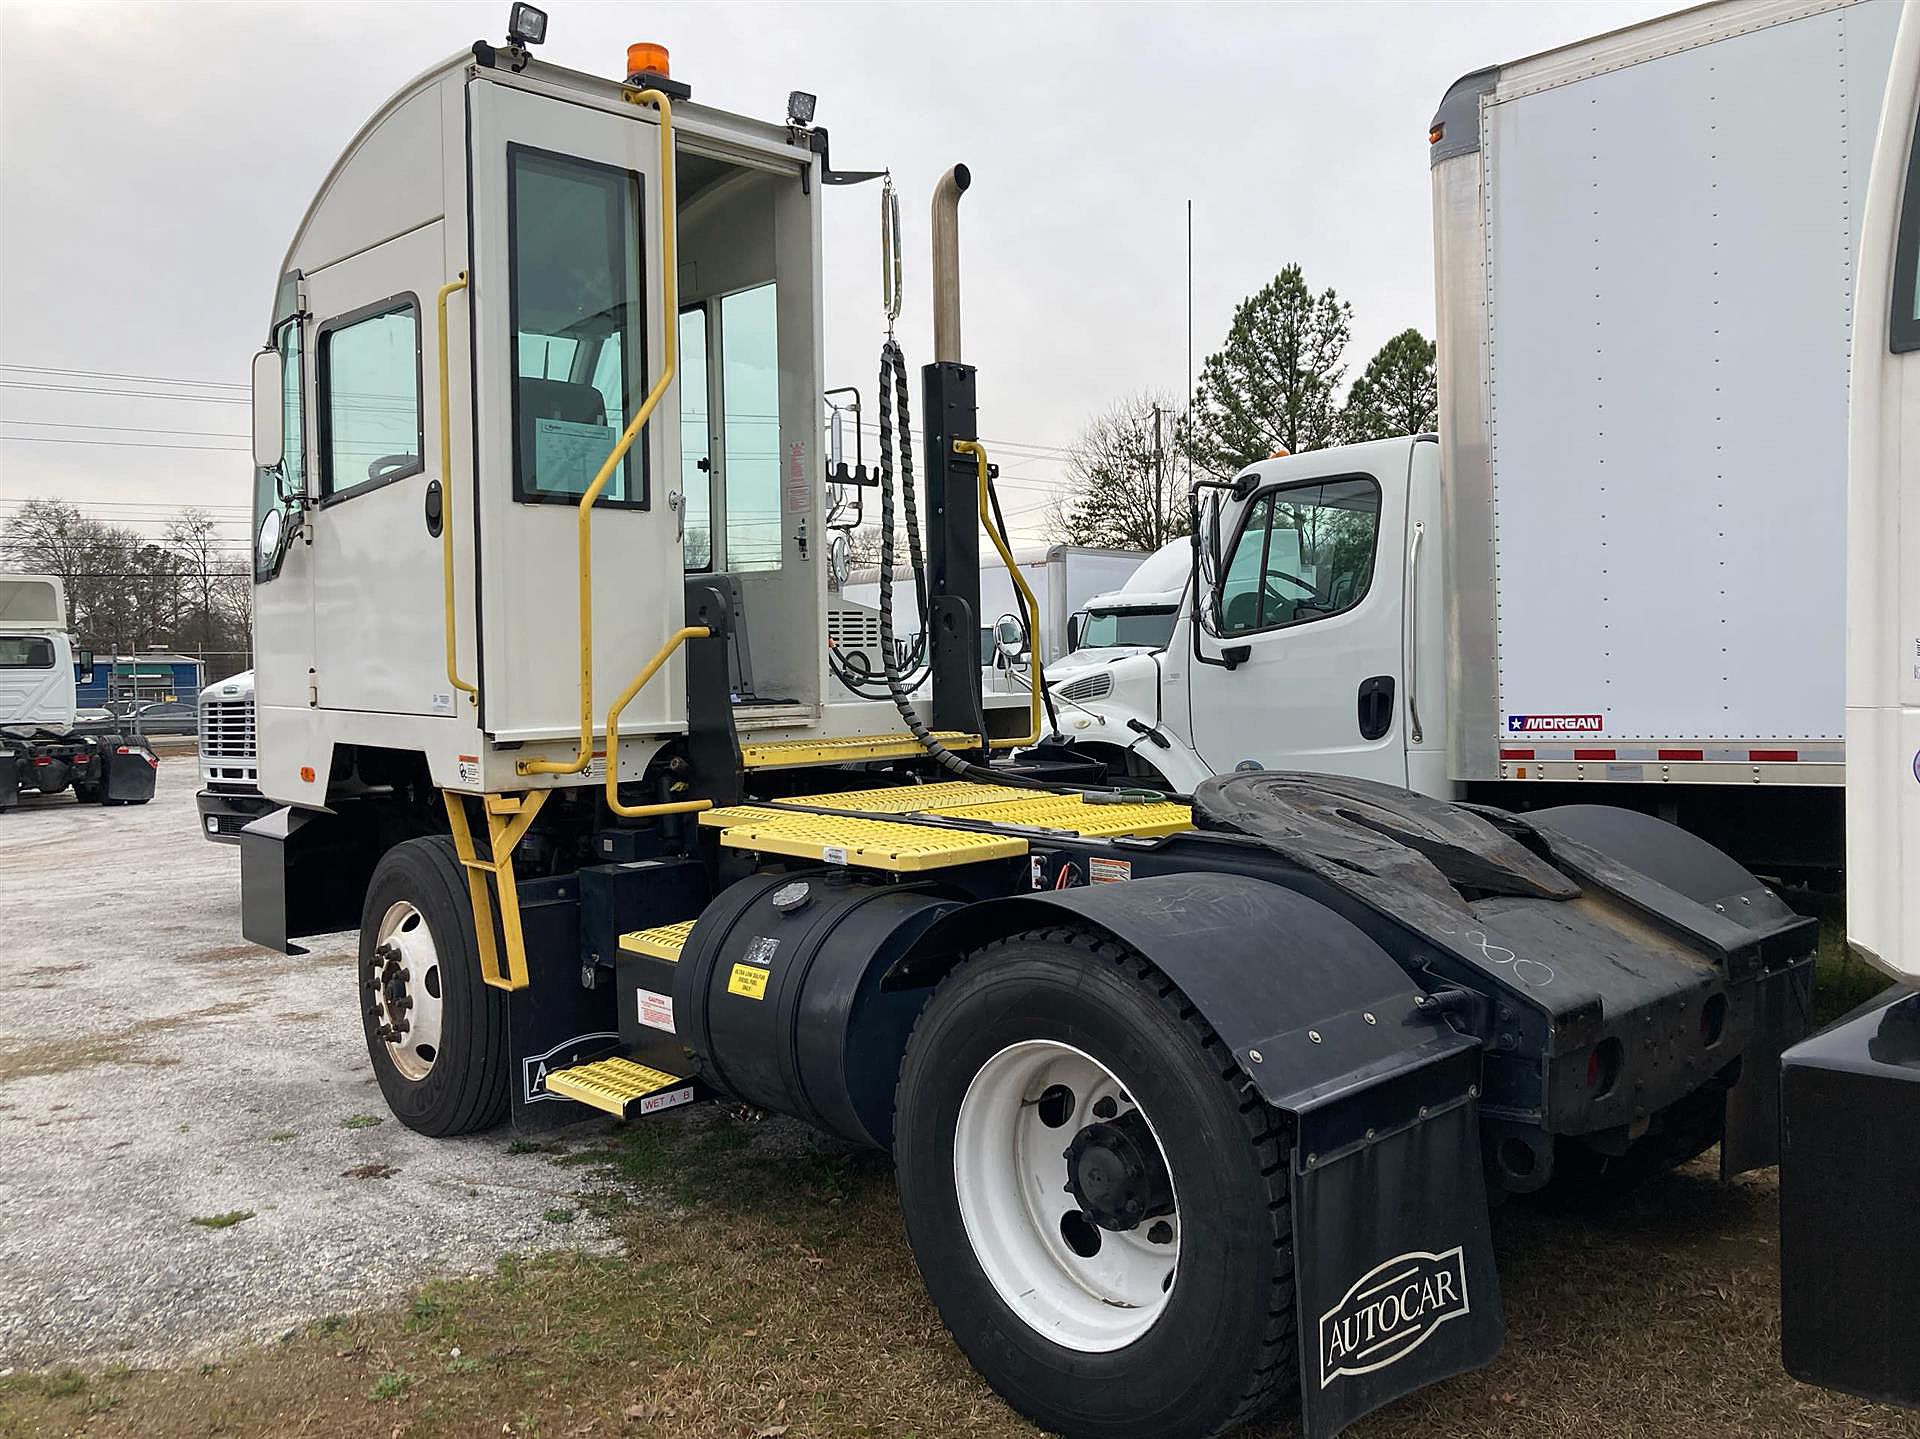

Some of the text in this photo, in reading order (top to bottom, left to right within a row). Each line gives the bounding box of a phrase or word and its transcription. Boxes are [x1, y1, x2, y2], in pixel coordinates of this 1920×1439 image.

[1525, 718, 1600, 729] MORGAN
[645, 1097, 664, 1110] WET
[669, 1094, 677, 1104] A
[1327, 1270, 1459, 1367] AUTOCAR
